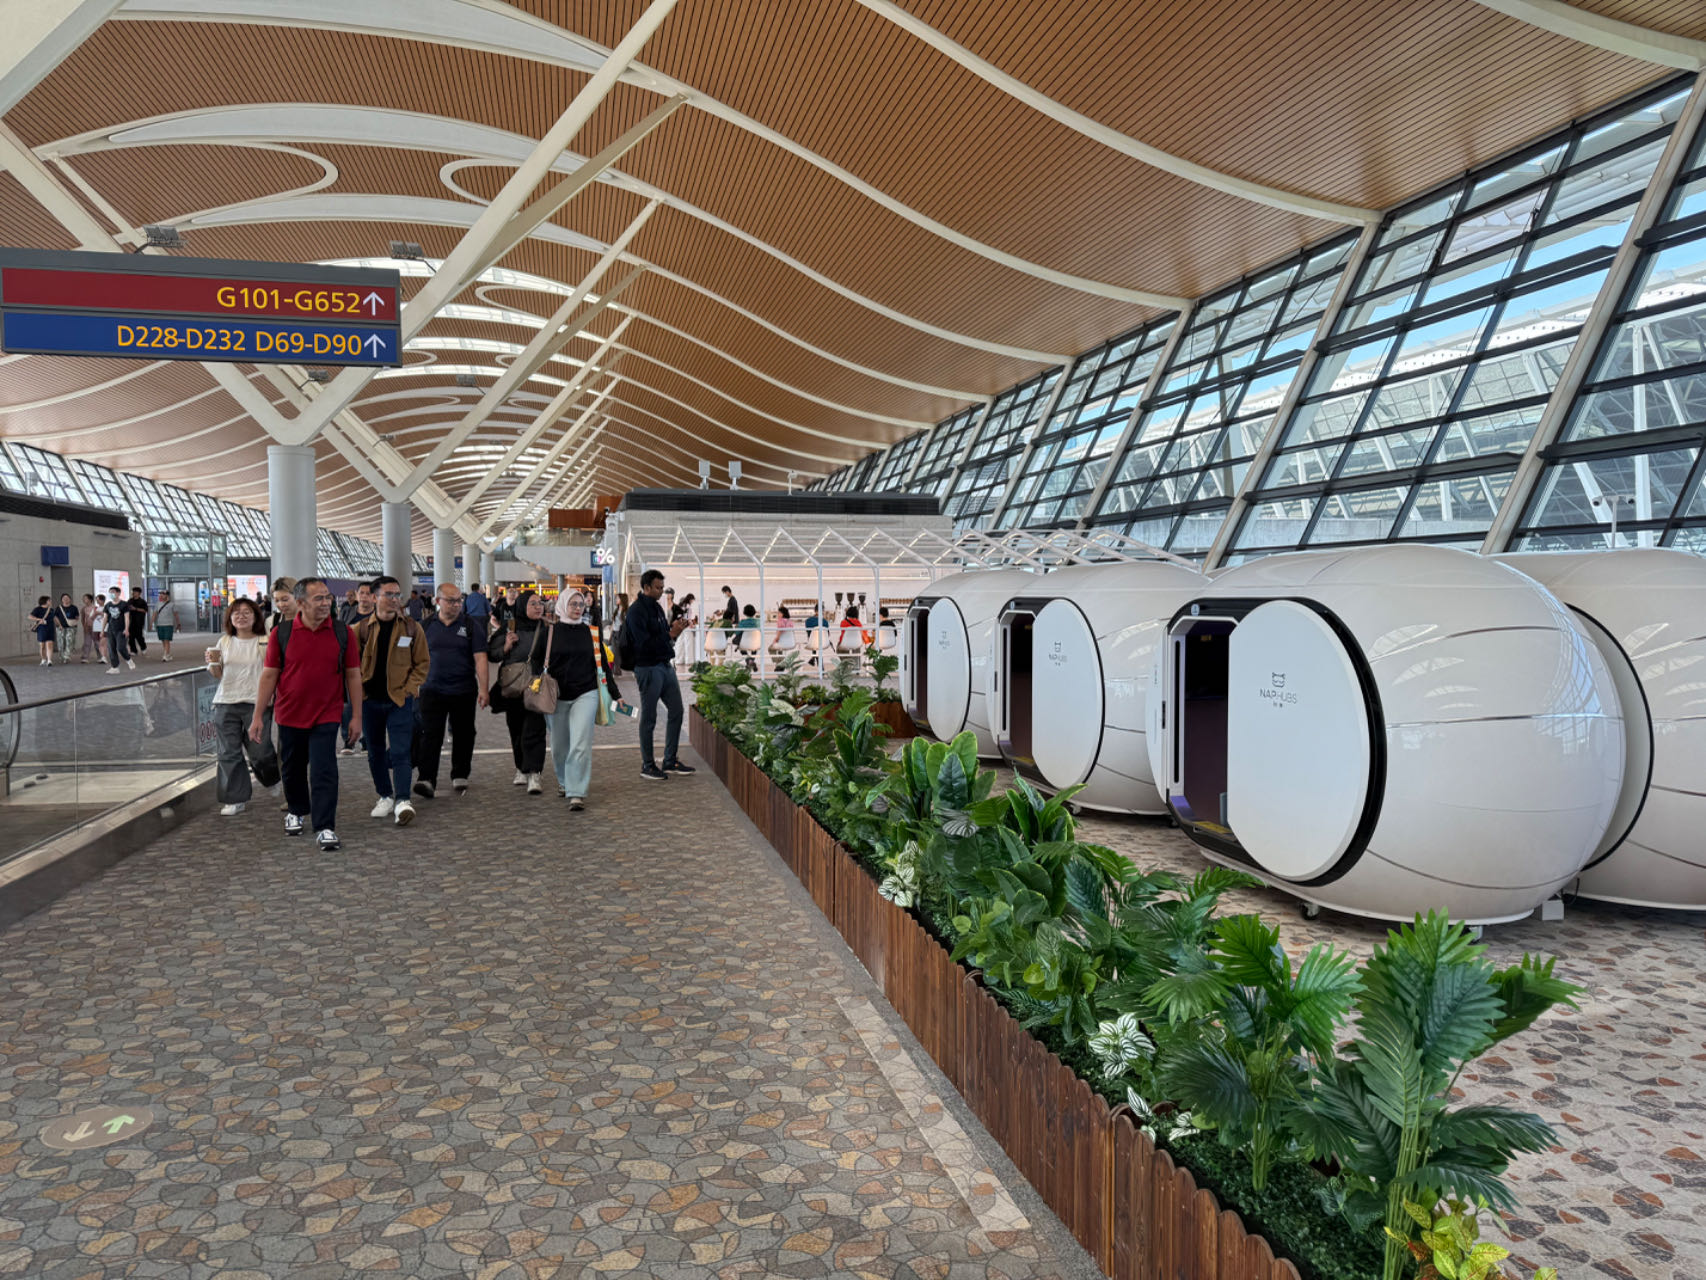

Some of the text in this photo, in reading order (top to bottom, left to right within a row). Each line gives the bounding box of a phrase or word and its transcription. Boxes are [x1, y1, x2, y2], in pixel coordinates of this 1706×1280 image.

[216, 286, 361, 313] G101-G652
[117, 325, 362, 356] D228-D232 D69-D90
